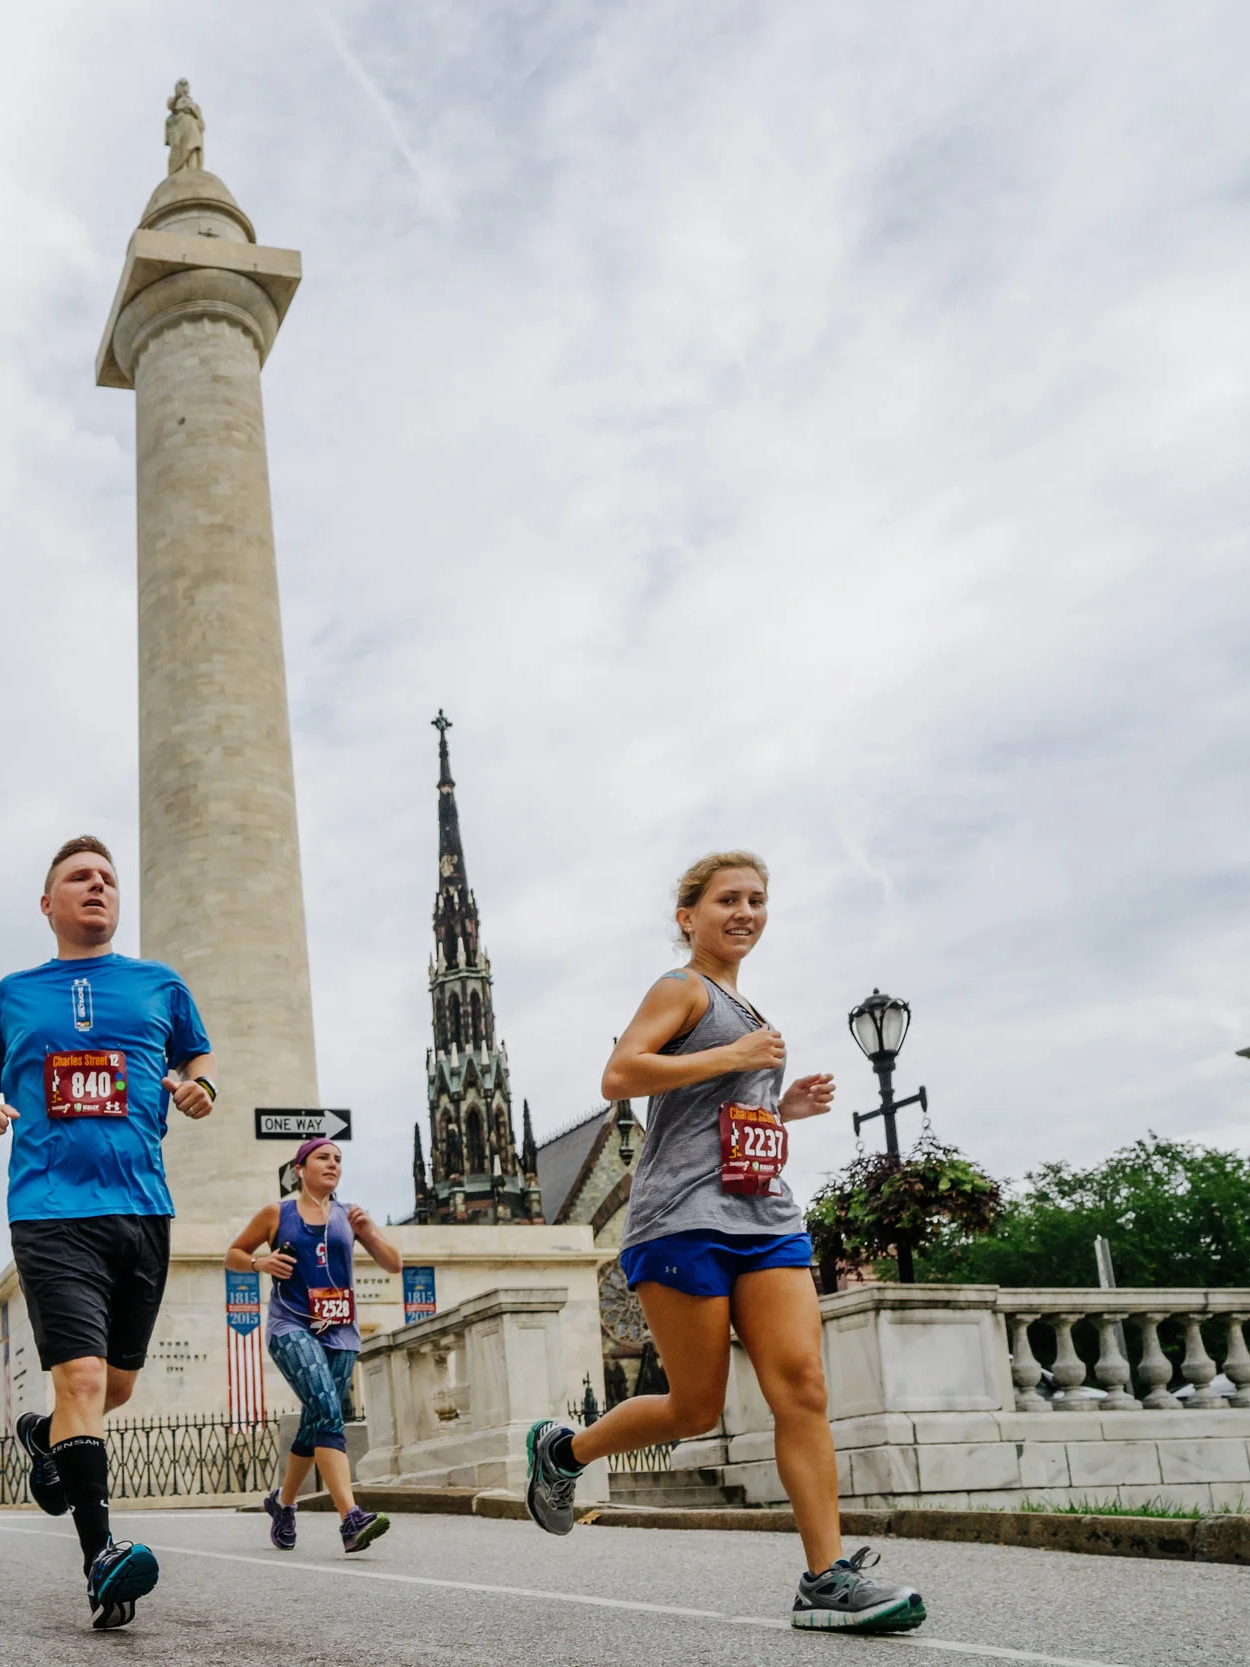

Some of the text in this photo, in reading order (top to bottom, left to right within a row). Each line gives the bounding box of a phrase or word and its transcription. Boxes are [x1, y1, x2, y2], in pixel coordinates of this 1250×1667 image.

[52, 1053, 119, 1067] Charles Street 12
[71, 1071, 111, 1098] 840
[265, 1118, 322, 1131] ONE WAY
[743, 1126, 784, 1159] 2237
[229, 1291, 259, 1304] 1815
[407, 1291, 434, 1304] 1815
[321, 1300, 350, 1317] 2528
[229, 1312, 259, 1325] 2015
